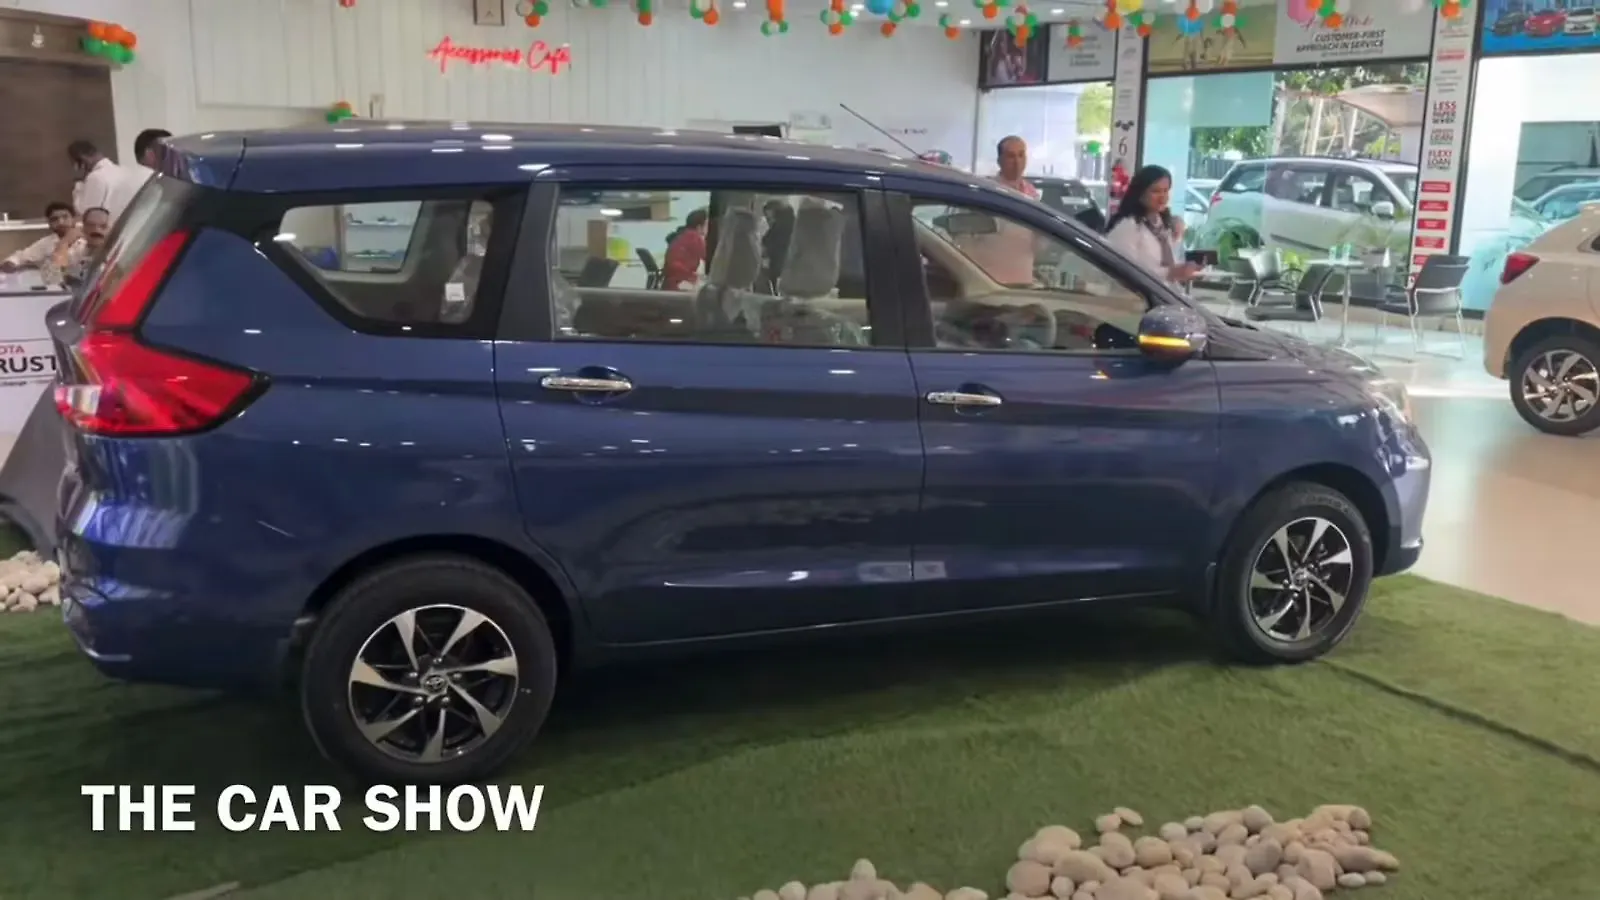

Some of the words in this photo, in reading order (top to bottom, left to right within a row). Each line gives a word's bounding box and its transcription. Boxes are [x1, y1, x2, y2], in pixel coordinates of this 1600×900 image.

[1315, 29, 1385, 42] CUSTOMER-FIRST
[1296, 42, 1338, 53] APPROACH
[1350, 39, 1384, 49] SERVICE
[1433, 101, 1456, 112] LESS
[1427, 158, 1451, 167] LOAN
